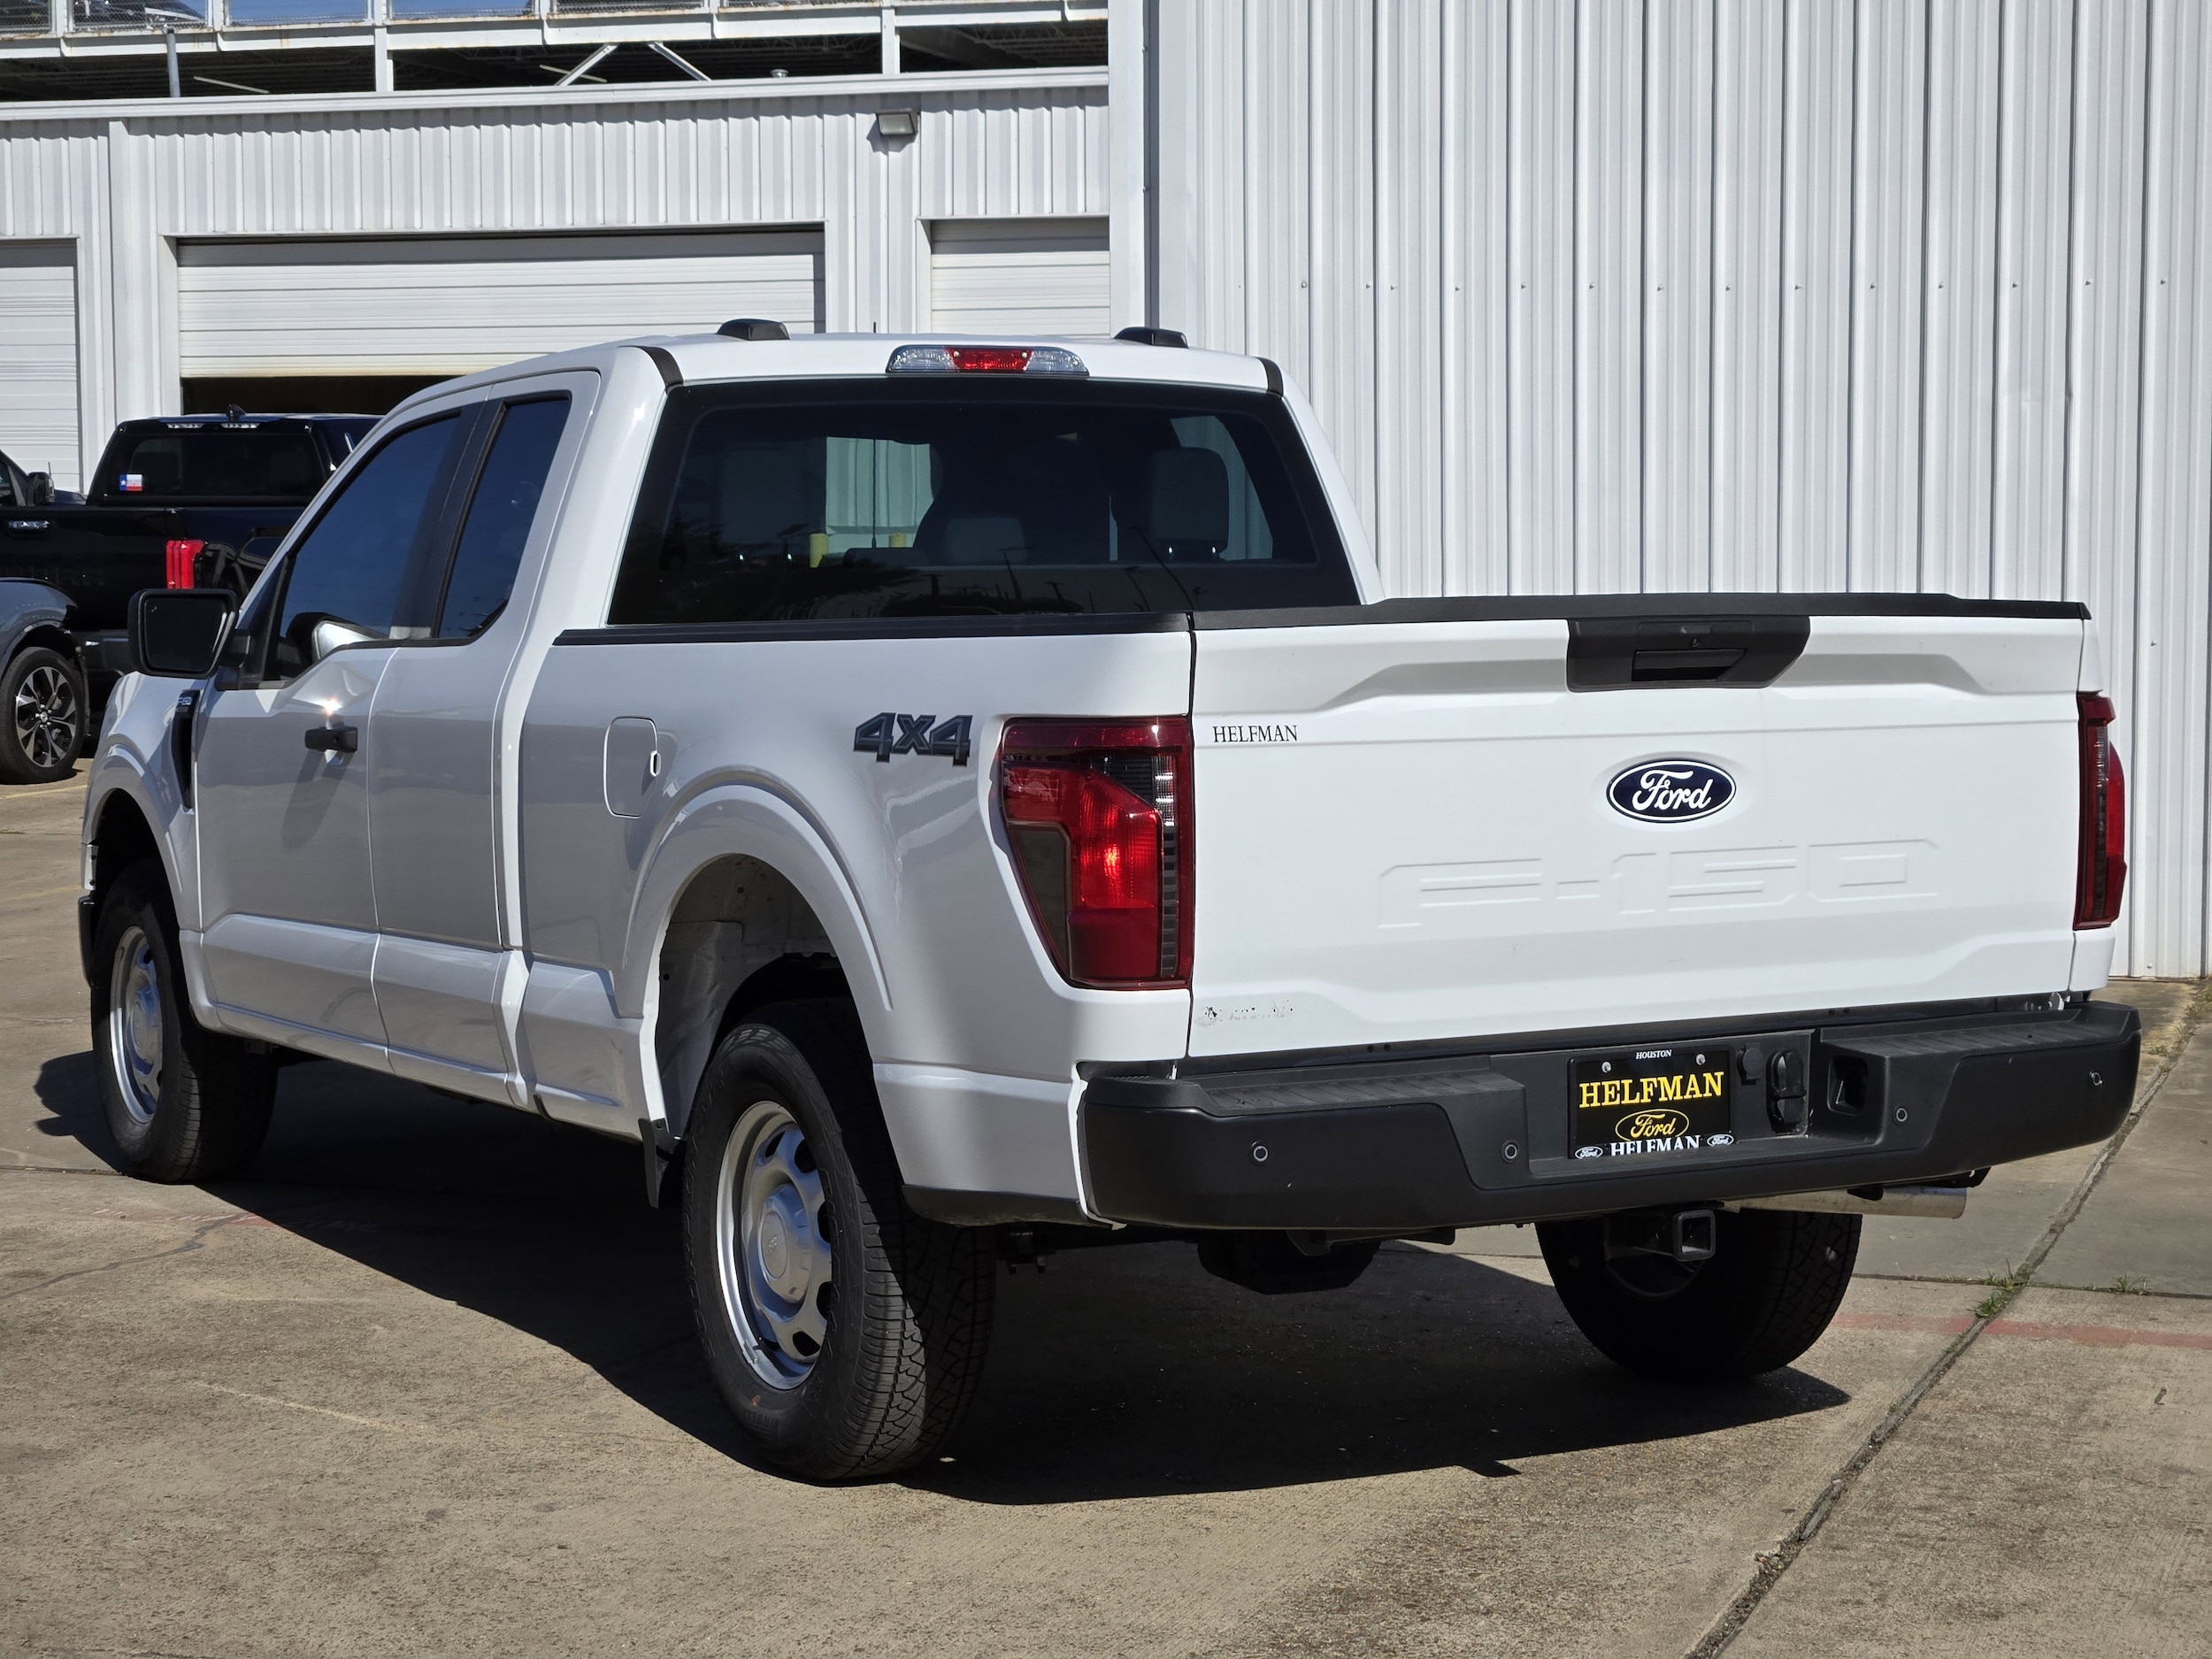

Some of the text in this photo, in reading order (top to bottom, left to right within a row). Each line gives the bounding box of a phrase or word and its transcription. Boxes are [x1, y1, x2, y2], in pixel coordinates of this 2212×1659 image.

[1213, 725, 1298, 743] HELFMAN
[1632, 769, 1712, 811] Ford
[1378, 838, 1939, 928] F-150
[1635, 1049, 1672, 1060] HOUSTON
[1579, 1071, 1724, 1109] HELFMAN
[1630, 1113, 1677, 1138] Ford
